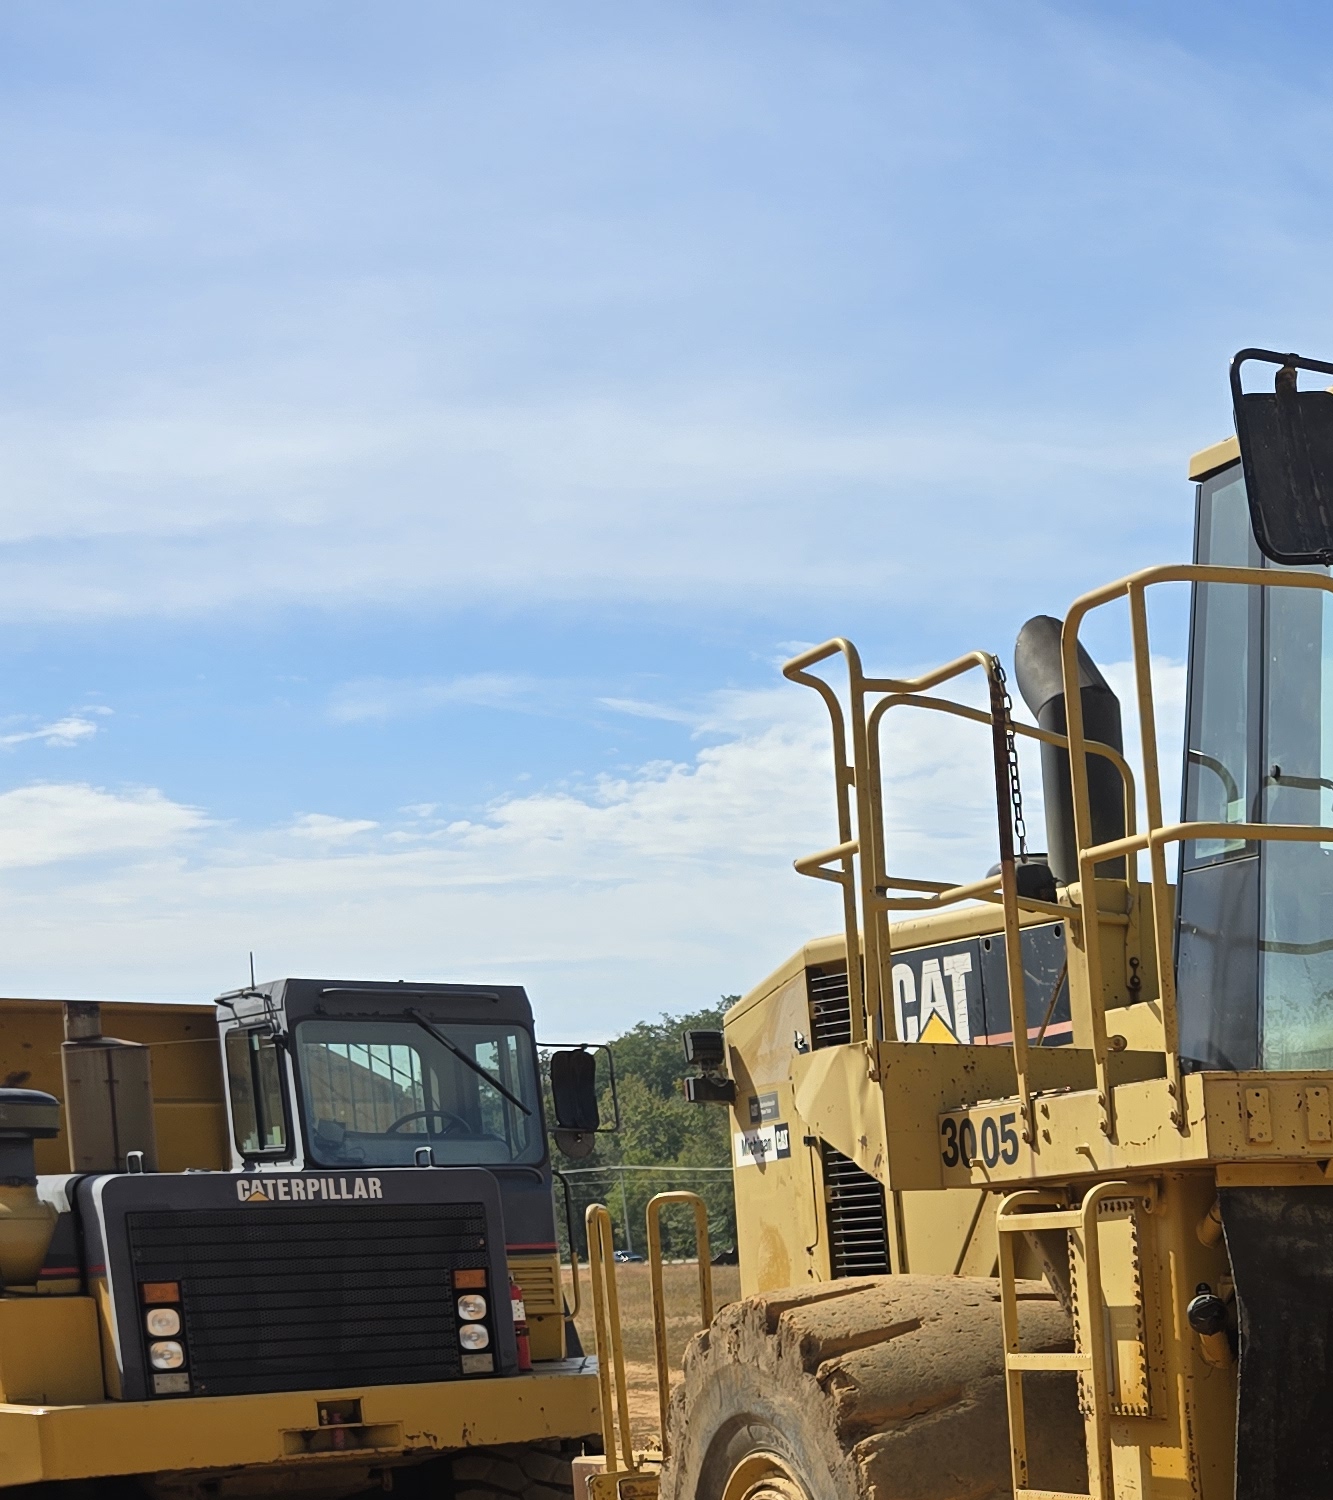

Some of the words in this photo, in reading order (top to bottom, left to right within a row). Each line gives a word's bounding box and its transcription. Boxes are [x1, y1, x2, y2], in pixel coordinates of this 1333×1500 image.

[891, 952, 972, 1044] CAT
[941, 1112, 1018, 1168] 3005
[236, 1177, 383, 1201] CATERPILLAR
